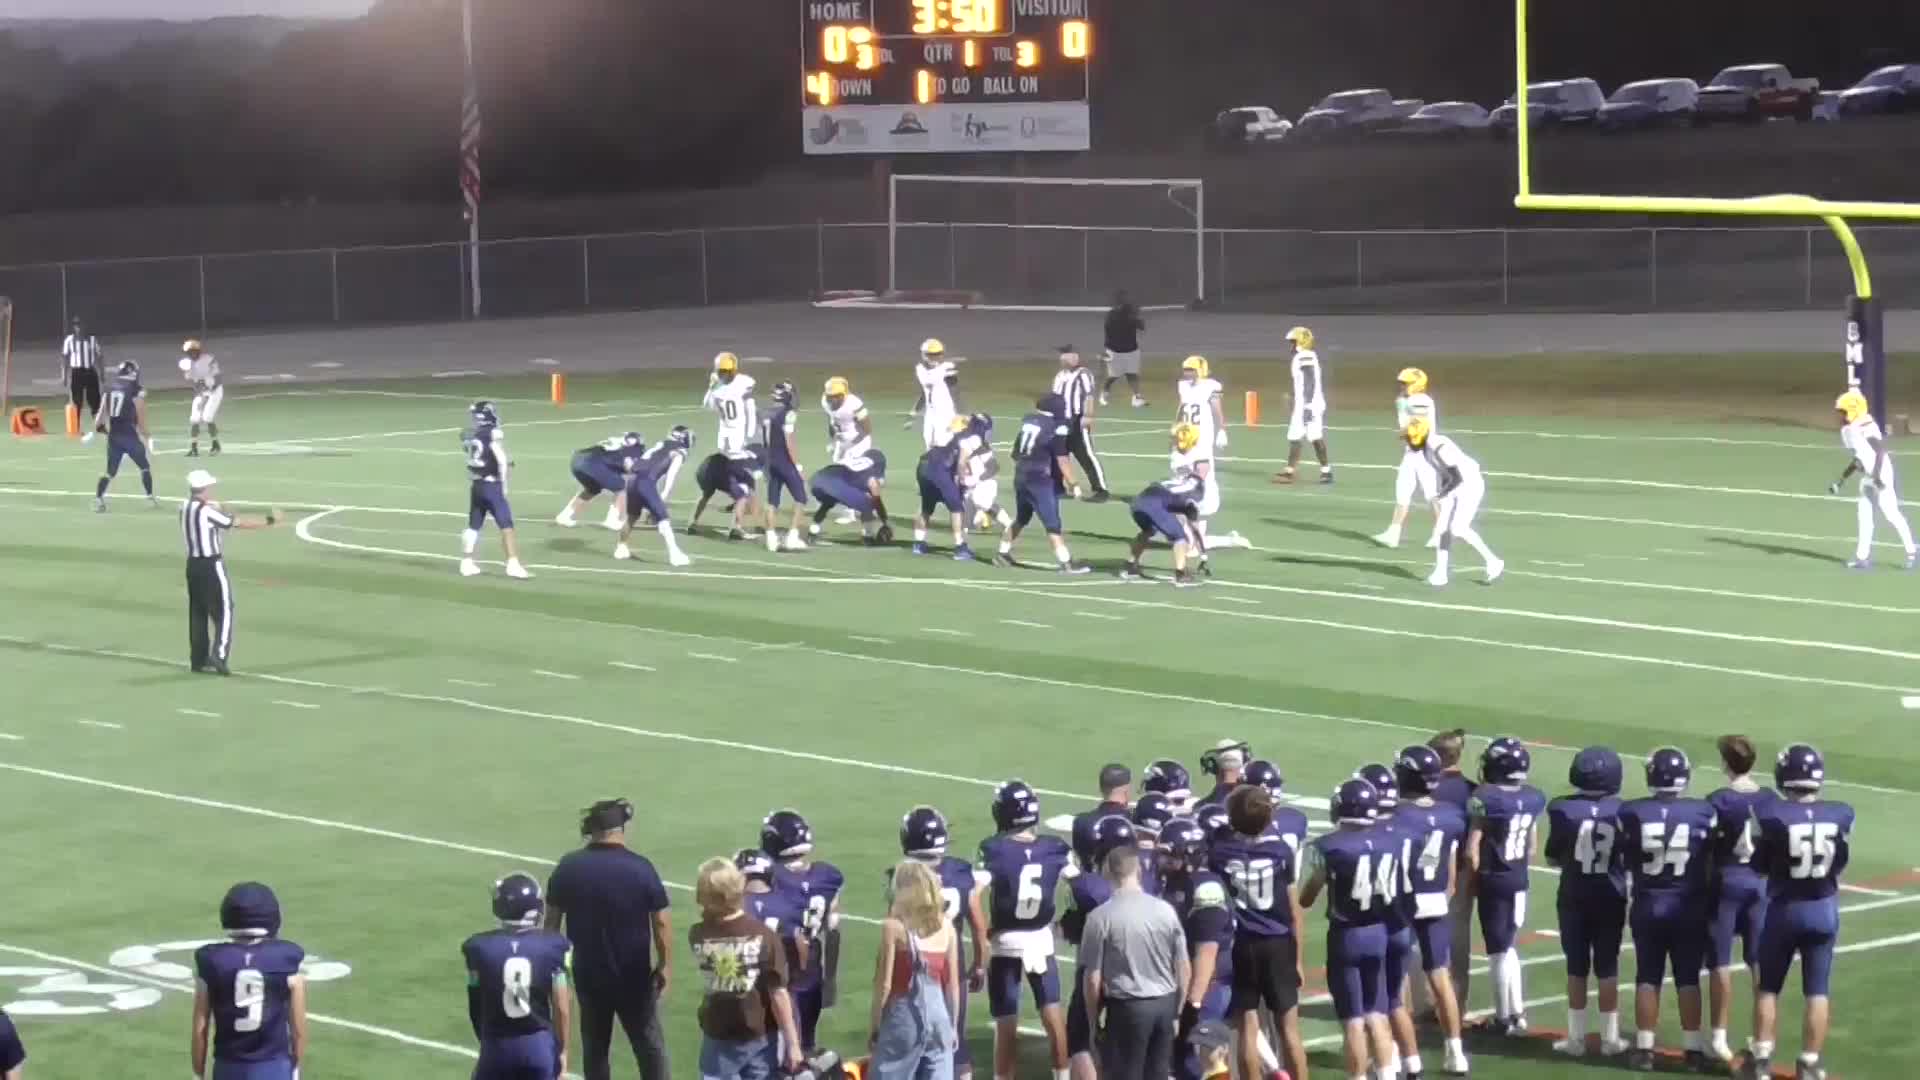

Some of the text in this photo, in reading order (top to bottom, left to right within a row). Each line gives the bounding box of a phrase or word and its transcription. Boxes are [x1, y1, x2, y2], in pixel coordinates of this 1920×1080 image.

[810, 3, 863, 20] HOME
[912, 0, 996, 33] 3:50
[923, 44, 952, 63] QTR
[964, 39, 975, 67] 1
[1016, 40, 1035, 68] 3
[1062, 21, 1087, 58] 0
[807, 71, 830, 105] 4
[917, 69, 929, 104] 1
[952, 77, 970, 94] GO
[983, 76, 1038, 94] BALL ON
[21, 409, 40, 428] G
[1642, 822, 1691, 877] 54
[1789, 823, 1839, 880] 55
[1016, 863, 1043, 920] 6
[234, 968, 265, 1032] 9
[503, 957, 531, 1019] 8
